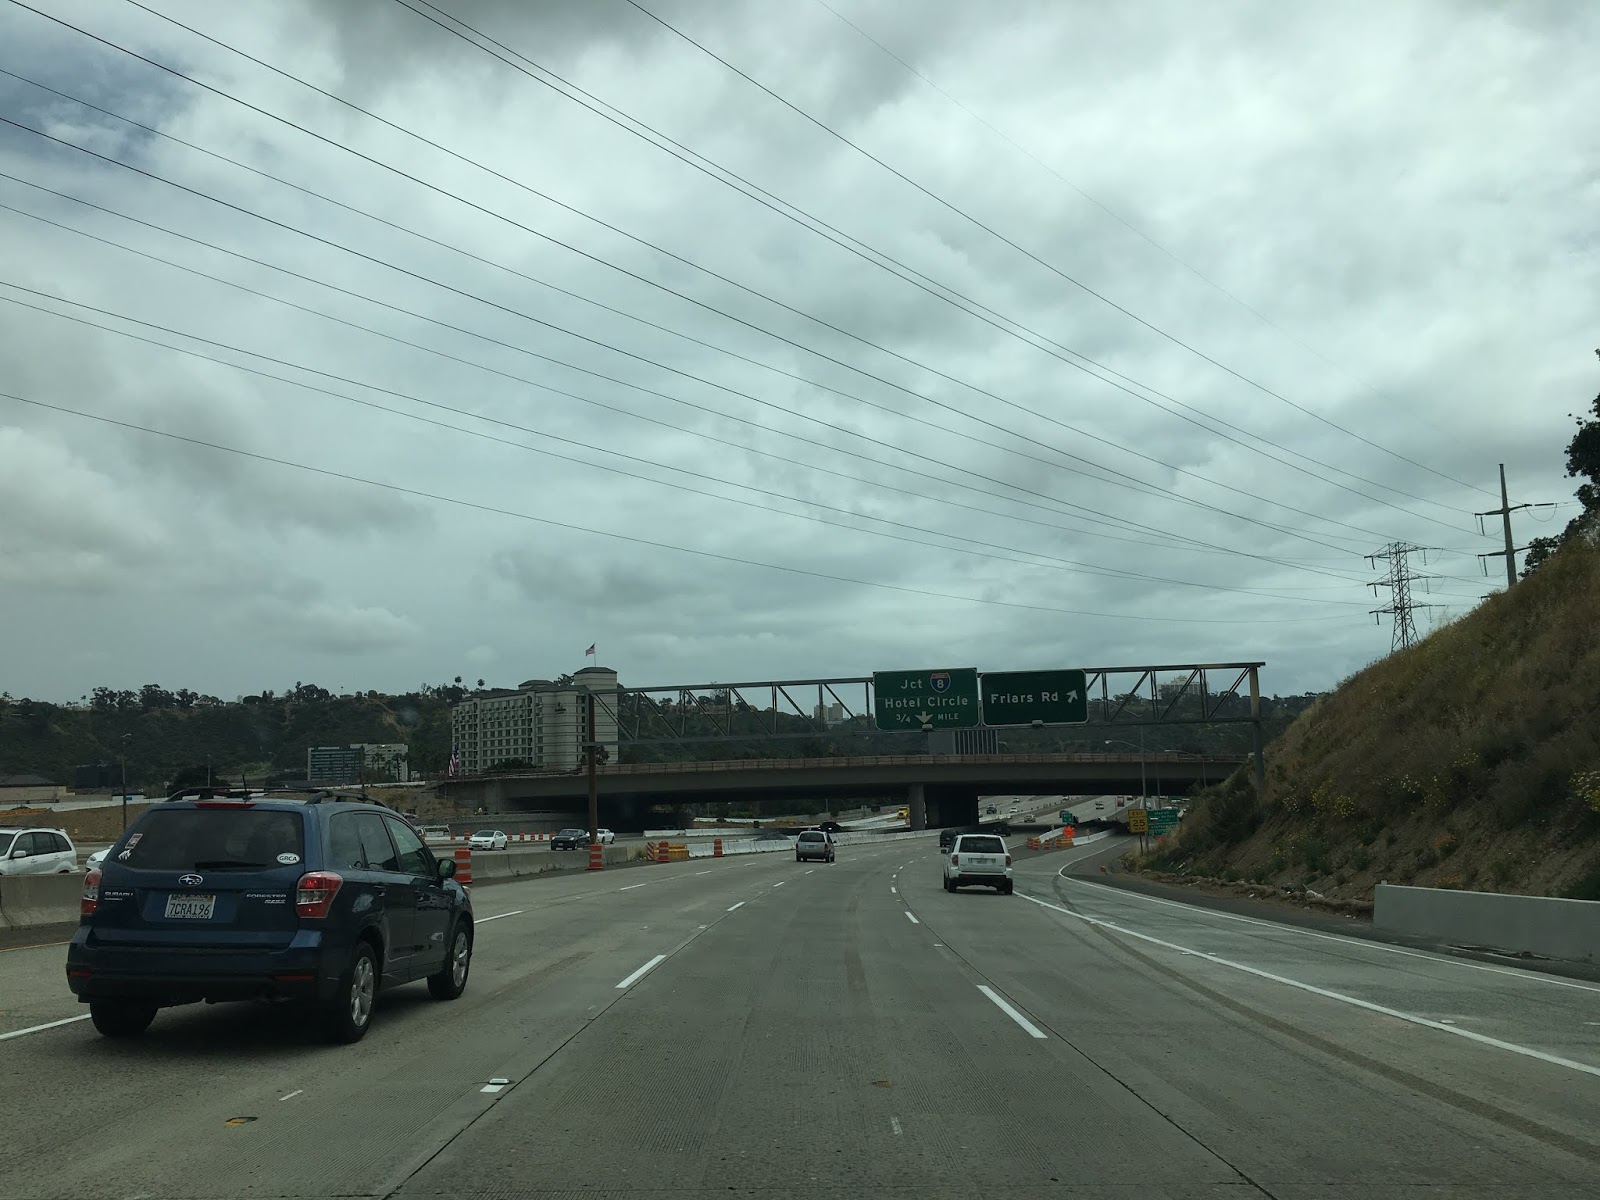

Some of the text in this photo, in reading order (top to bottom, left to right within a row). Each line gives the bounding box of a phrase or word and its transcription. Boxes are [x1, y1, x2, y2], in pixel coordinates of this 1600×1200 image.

[900, 679, 945, 689] Jct 8
[885, 695, 968, 708] Hotel Circle
[990, 691, 1059, 704] Friars Rd
[896, 713, 959, 723] 3/4 MILE
[1132, 819, 1146, 827] 25
[169, 903, 212, 916] 7CRA196
